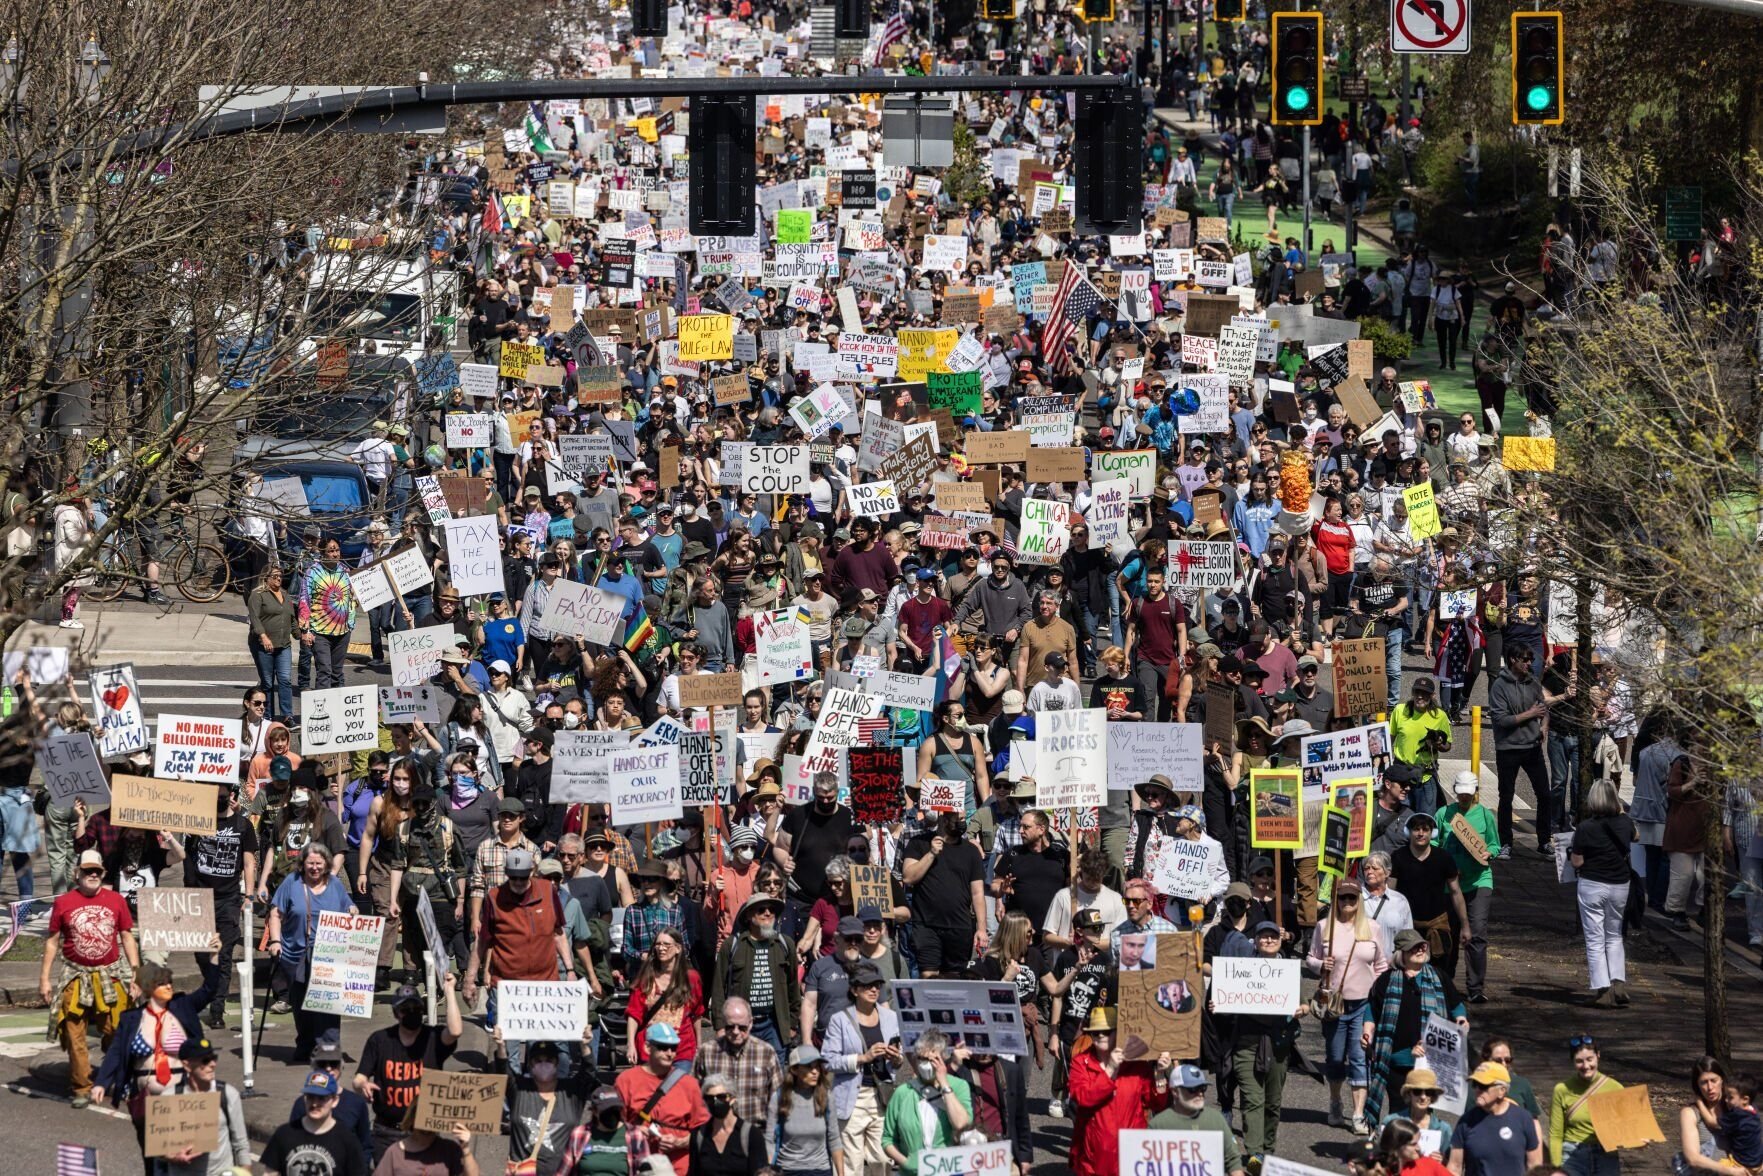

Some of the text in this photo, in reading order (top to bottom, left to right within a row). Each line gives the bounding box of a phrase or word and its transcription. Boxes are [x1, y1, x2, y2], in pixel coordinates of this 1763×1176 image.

[624, 227, 652, 239] HANDS
[702, 253, 733, 263] TRUMP
[1201, 261, 1227, 269] HANDS
[701, 263, 732, 273] GOLFS
[862, 265, 893, 275] PRUNERS
[865, 270, 880, 278] NOT
[1201, 268, 1227, 280] OFF!
[1014, 271, 1039, 282] OTHER
[1125, 273, 1145, 288] NO
[796, 289, 819, 301] HANDS
[848, 280, 891, 296] CHAINSAWS
[680, 315, 731, 333] PROTECT
[845, 334, 894, 346] STOP MUSK
[1223, 328, 1246, 341] This
[507, 342, 541, 355] TRUMP IS
[680, 340, 701, 355] RULE
[702, 344, 710, 353] OF
[711, 340, 732, 355] LAW
[839, 343, 898, 355] KICK HIM IN THE
[1183, 335, 1216, 350] PEACE
[929, 373, 979, 387] PROTECT
[1180, 375, 1221, 388] HANDS
[928, 386, 981, 398] IMMIGRANTS
[1202, 387, 1226, 398] OFF
[1061, 396, 1070, 404] IS
[1023, 403, 1075, 416] COMPLIANCE
[461, 428, 473, 437] NO
[911, 436, 926, 454] my
[988, 442, 1005, 450] BAD
[562, 454, 598, 465] LOVE THE
[749, 446, 801, 464] STOP
[762, 465, 782, 475] the
[747, 475, 802, 493] COUP
[938, 484, 983, 494] DEPORT HATE
[853, 488, 872, 500] NO
[1096, 489, 1122, 504] make
[1408, 488, 1429, 502] VOTE
[861, 499, 895, 514] KING
[939, 496, 957, 507] NOT
[1407, 498, 1434, 513] DEMOCRAT
[1025, 501, 1067, 521] CHINGA
[1095, 506, 1126, 522] LYING
[447, 523, 492, 545] TAX
[1023, 534, 1062, 555] MAGA
[1189, 542, 1231, 557] KEEP YOUR
[461, 547, 484, 559] THE
[1190, 555, 1232, 570] RELIGION
[452, 561, 496, 581] RICH
[1191, 572, 1232, 587] MY BODY
[579, 587, 602, 604] NO
[554, 598, 619, 630] FASCISM
[389, 631, 435, 655] PARKS
[1333, 654, 1358, 668] AND
[887, 672, 923, 686] RESIST
[1335, 666, 1373, 681] DONALD
[682, 675, 738, 690] NO MORE
[884, 683, 898, 693] the
[1336, 679, 1372, 693] PUBLIC
[344, 693, 364, 705] GET
[681, 687, 740, 701] BILLIONAIRES
[1338, 692, 1376, 706] HEALTH
[830, 689, 875, 717] HANDS
[1339, 702, 1386, 718] DISASTER
[101, 710, 135, 729] RULE
[176, 721, 225, 736] NO MORE
[308, 724, 331, 733] DOGE
[1136, 726, 1185, 743] Hands Off
[104, 727, 143, 753] LAW
[162, 733, 237, 750] BILLIONAIRES
[574, 734, 614, 744] PEPFAR
[679, 734, 724, 755] HANDS
[817, 730, 859, 748] DEMOCRACY
[1042, 734, 1099, 753] PROCESS
[1346, 734, 1361, 745] MEN
[40, 740, 91, 767] WE THE
[170, 750, 226, 764] TAX THE
[558, 747, 592, 758] SAVES
[874, 751, 901, 767] THE
[1347, 750, 1362, 759] Kids
[163, 761, 234, 777] RICH NOW!
[612, 751, 669, 773] HANDS OFF
[45, 769, 101, 795] PEOPLE
[631, 774, 657, 788] OUR
[851, 773, 901, 792] STORY
[124, 781, 196, 806] We People
[616, 787, 676, 806] DEMOCRACY!
[929, 791, 954, 801] GOOD
[933, 785, 951, 795] NO
[1060, 784, 1078, 797] JUST
[855, 792, 899, 804] CHANNEL
[1038, 794, 1079, 806] RICH WHITE
[1454, 820, 1486, 859] CANCEL
[1174, 841, 1209, 860] HANDS
[854, 866, 889, 882] LOVE
[860, 886, 889, 898] IS THE
[151, 891, 202, 917] KING
[319, 914, 380, 934] HANDS OFF!
[141, 928, 213, 948] AMERIKKKA
[318, 930, 348, 945] SCIENCE
[345, 970, 370, 982] Unions
[1258, 962, 1284, 980] OFF
[504, 985, 583, 999] VETERANS
[1120, 985, 1141, 997] This
[1246, 981, 1268, 990] OUR
[1216, 990, 1289, 1009] DEMOCRACY
[305, 1000, 365, 1016] Courts ARTS
[508, 1002, 576, 1014] AGAINST
[1119, 1008, 1144, 1022] Shall
[504, 1018, 579, 1032] TYRANNY
[1427, 1022, 1460, 1043] HANDS
[449, 1074, 483, 1087] MAKE
[427, 1082, 500, 1102] TELLING THE
[178, 1100, 207, 1112] DOGE
[429, 1102, 477, 1119] TRUTH
[425, 1118, 457, 1131] RIGHT
[1141, 1139, 1202, 1161] SUPER
[922, 1148, 1007, 1176] SAVE OUR
